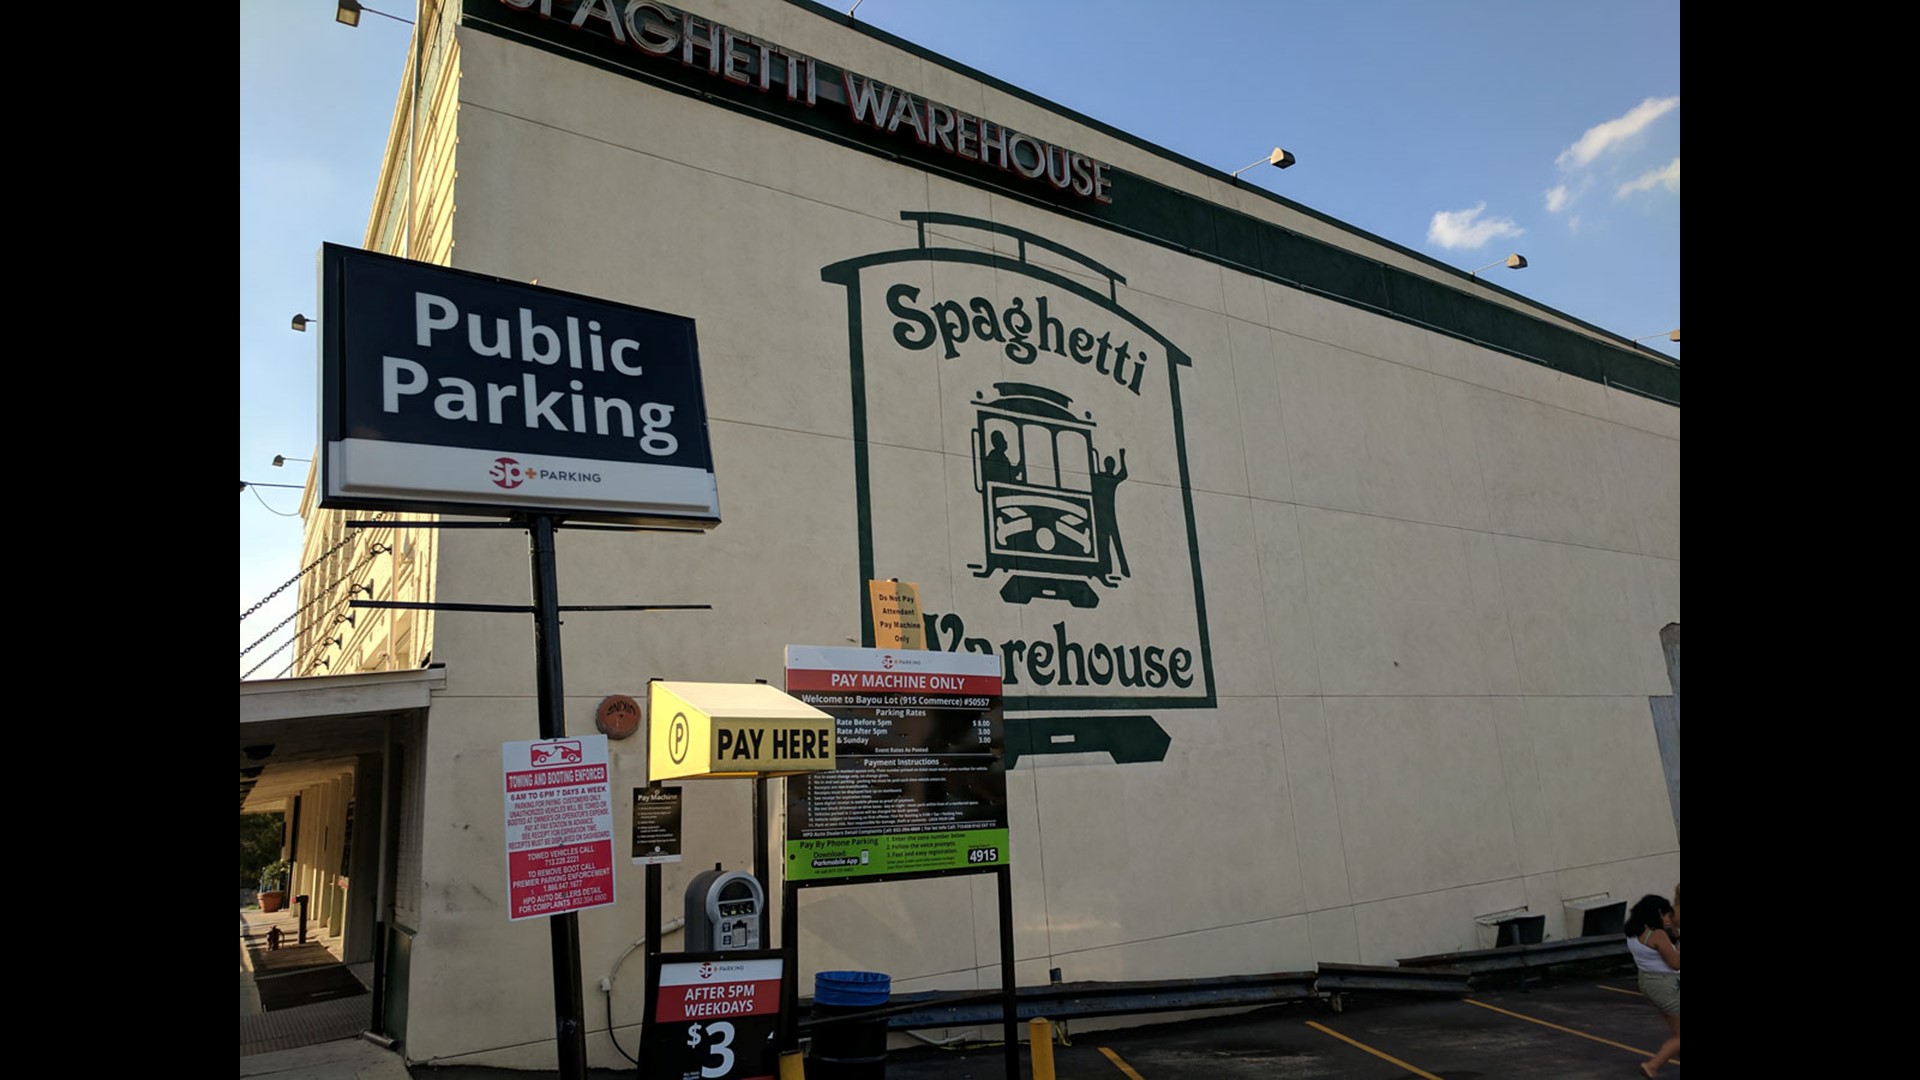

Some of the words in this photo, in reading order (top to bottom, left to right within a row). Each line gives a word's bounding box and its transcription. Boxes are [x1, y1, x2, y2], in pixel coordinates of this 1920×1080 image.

[842, 69, 1113, 205] WAREHOUSE
[415, 291, 643, 377] Public
[886, 284, 1147, 396] Spaghetti
[382, 355, 679, 457] Parking
[539, 469, 602, 484] PARKING
[902, 595, 914, 604] Pay
[882, 607, 915, 615] Attendant
[880, 620, 892, 629] Pay
[893, 620, 921, 629] Machine
[894, 635, 909, 644] Only
[831, 673, 858, 687] PAY
[862, 674, 926, 689] MACHINE
[929, 676, 965, 690] ONLY
[801, 694, 843, 703] Welcome
[844, 695, 854, 703] to
[856, 695, 882, 706] Bayou
[884, 696, 898, 704] Lot
[900, 696, 917, 706] (915
[918, 696, 963, 706] Commerce)
[875, 709, 904, 718] Parking
[877, 719, 892, 727] 5pm
[717, 728, 765, 760] PAY
[773, 728, 829, 760] HERE
[843, 737, 869, 746] Sunday
[864, 758, 896, 768] Payment
[897, 758, 940, 766] Instructions
[508, 773, 533, 788] TOWING
[534, 772, 546, 785] AND
[547, 771, 573, 784] BOOTING
[574, 767, 605, 782] ENFORCED
[562, 788, 579, 796] DAYS
[637, 794, 650, 803] Pay
[650, 793, 678, 801] Machine
[800, 841, 814, 849] Pay
[816, 839, 825, 849] By
[827, 839, 850, 847] Phone
[851, 837, 879, 846] Parking
[528, 852, 549, 861] TOWED
[550, 848, 578, 857] VEHICLES
[579, 845, 594, 853] CALL
[969, 848, 997, 862] 4915
[537, 868, 562, 877] REMOVE
[563, 865, 580, 874] BOOT
[580, 863, 596, 871] CALL
[512, 879, 540, 889] PREMIER
[540, 874, 567, 884] PARKING
[567, 867, 610, 880] ENFORCEMENT
[537, 894, 554, 903] AUTO
[582, 887, 602, 896] DETAIL
[518, 905, 532, 913] FOR
[532, 900, 571, 912] COMPLAINTS
[684, 987, 725, 1001] AFTER
[728, 984, 755, 998] 5PM
[684, 1000, 754, 1017] WEEKDAYS
